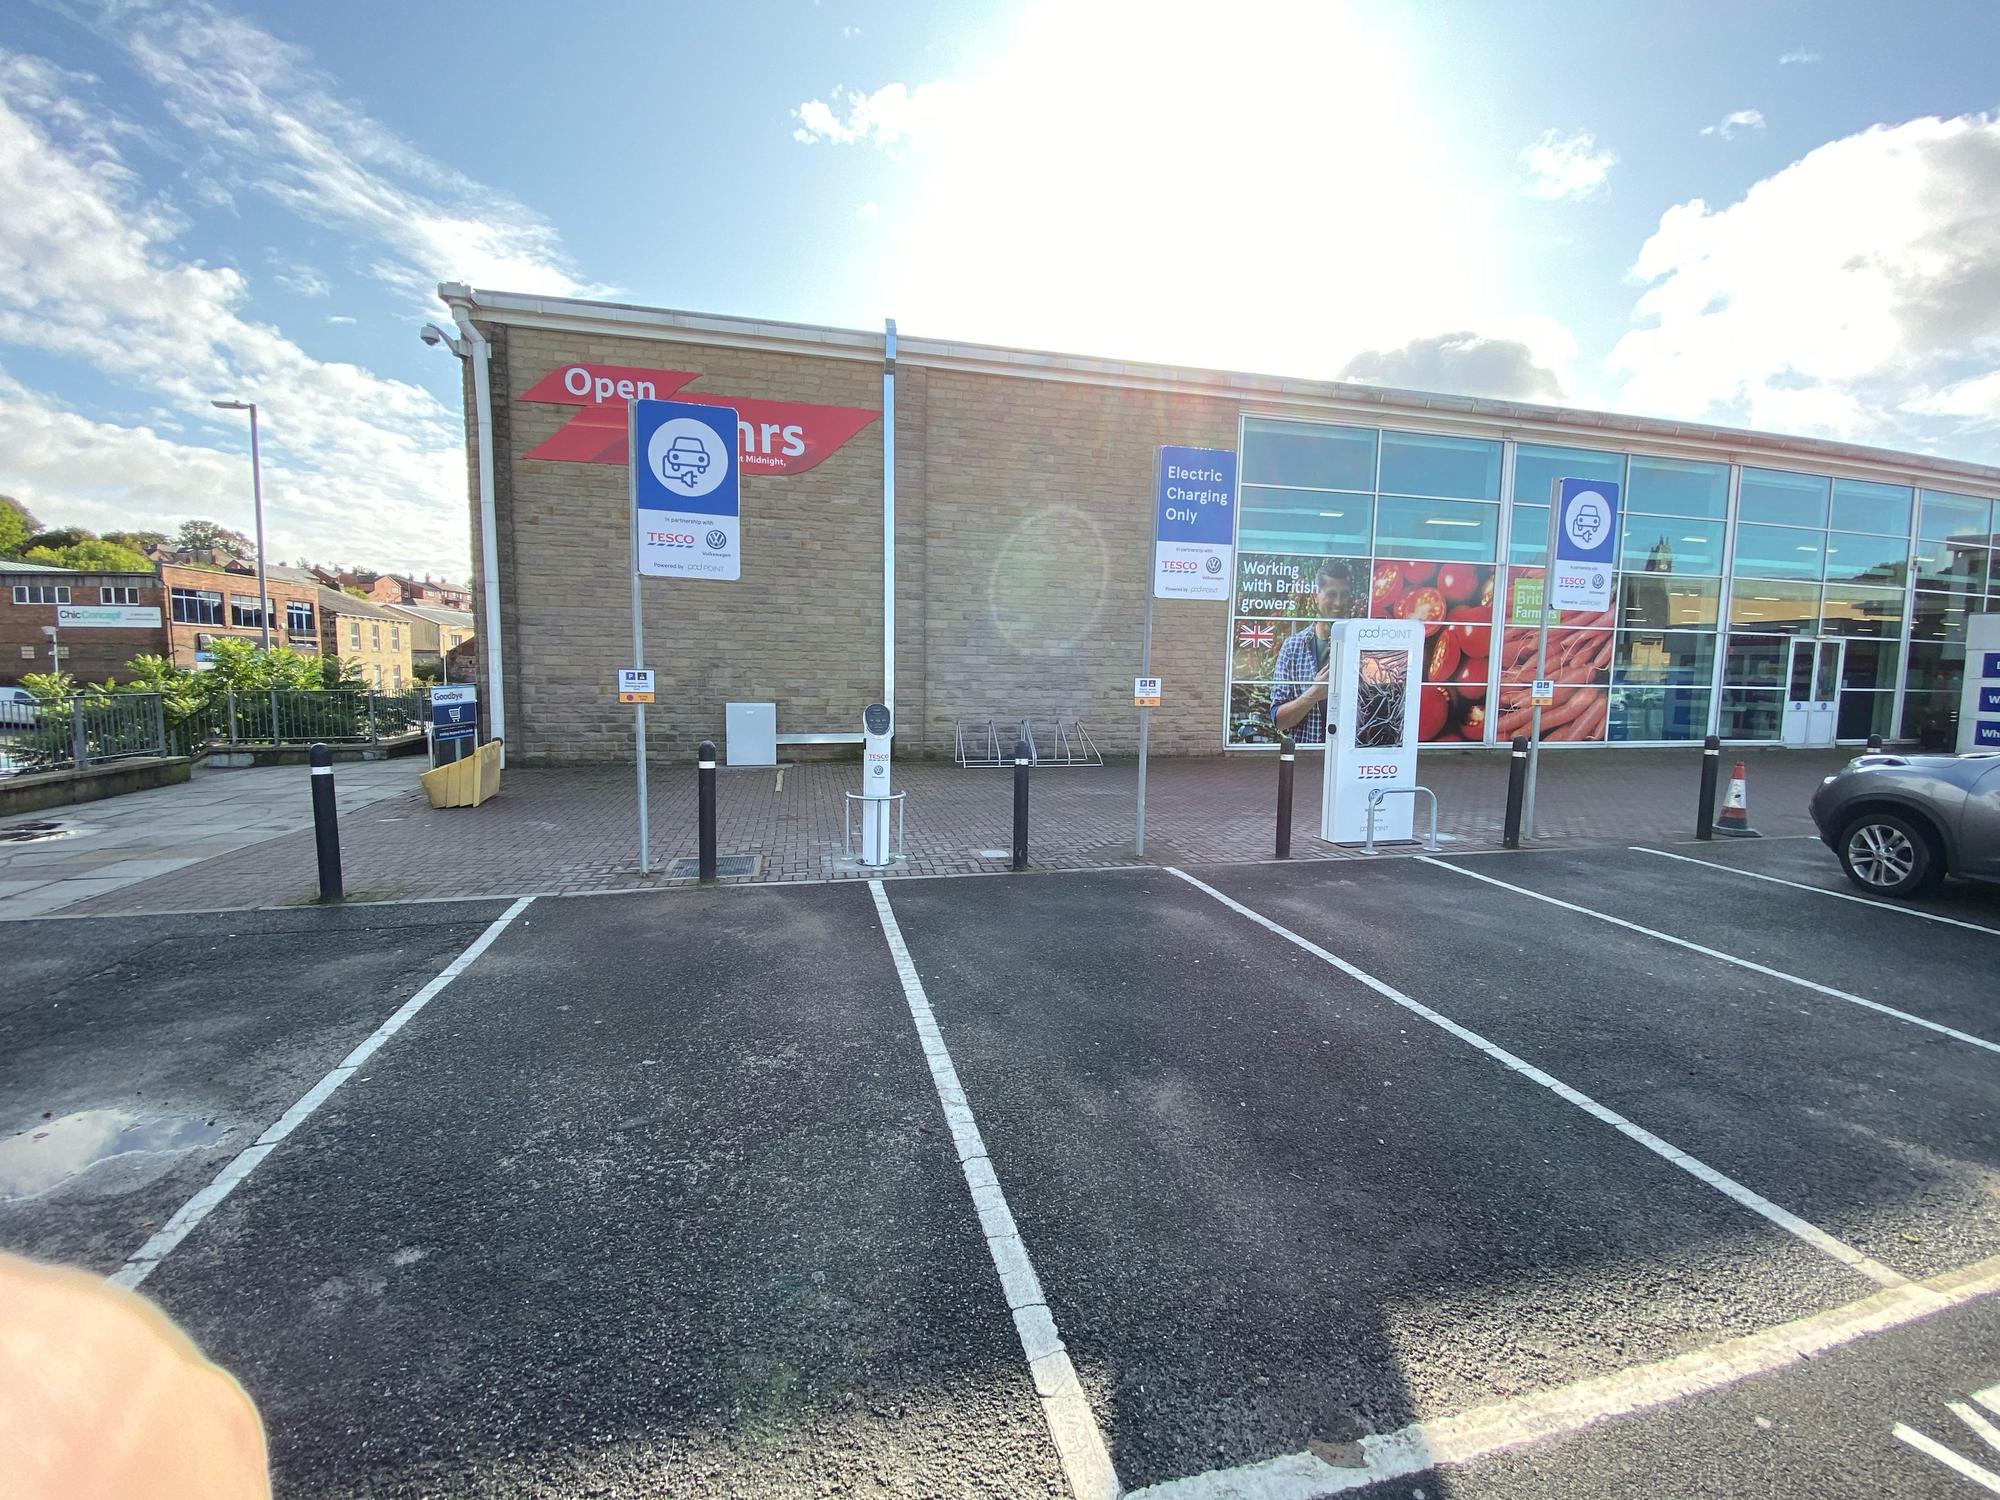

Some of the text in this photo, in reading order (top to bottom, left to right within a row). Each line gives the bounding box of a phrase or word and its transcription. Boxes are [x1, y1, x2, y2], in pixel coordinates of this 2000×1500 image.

[564, 367, 656, 403] Open
[746, 455, 786, 467] Midnight,
[1168, 465, 1223, 482] Electric
[1166, 487, 1228, 506] Charging
[671, 518, 702, 526] partnership
[1165, 507, 1198, 525] Only
[647, 531, 695, 545] TESCO
[703, 564, 725, 573] POINT
[1162, 560, 1198, 570] TESCO
[1243, 560, 1300, 579] Working
[1242, 578, 1320, 594] with British
[1559, 576, 1586, 586] TESCO
[1517, 590, 1544, 606] Briti
[1240, 598, 1296, 613] growers
[1515, 606, 1558, 619] Farmrs
[1358, 624, 1412, 642] pod POINT
[433, 691, 463, 701] Goodbye
[1981, 728, 2000, 738] Wh
[1358, 764, 1398, 775] TESCO
